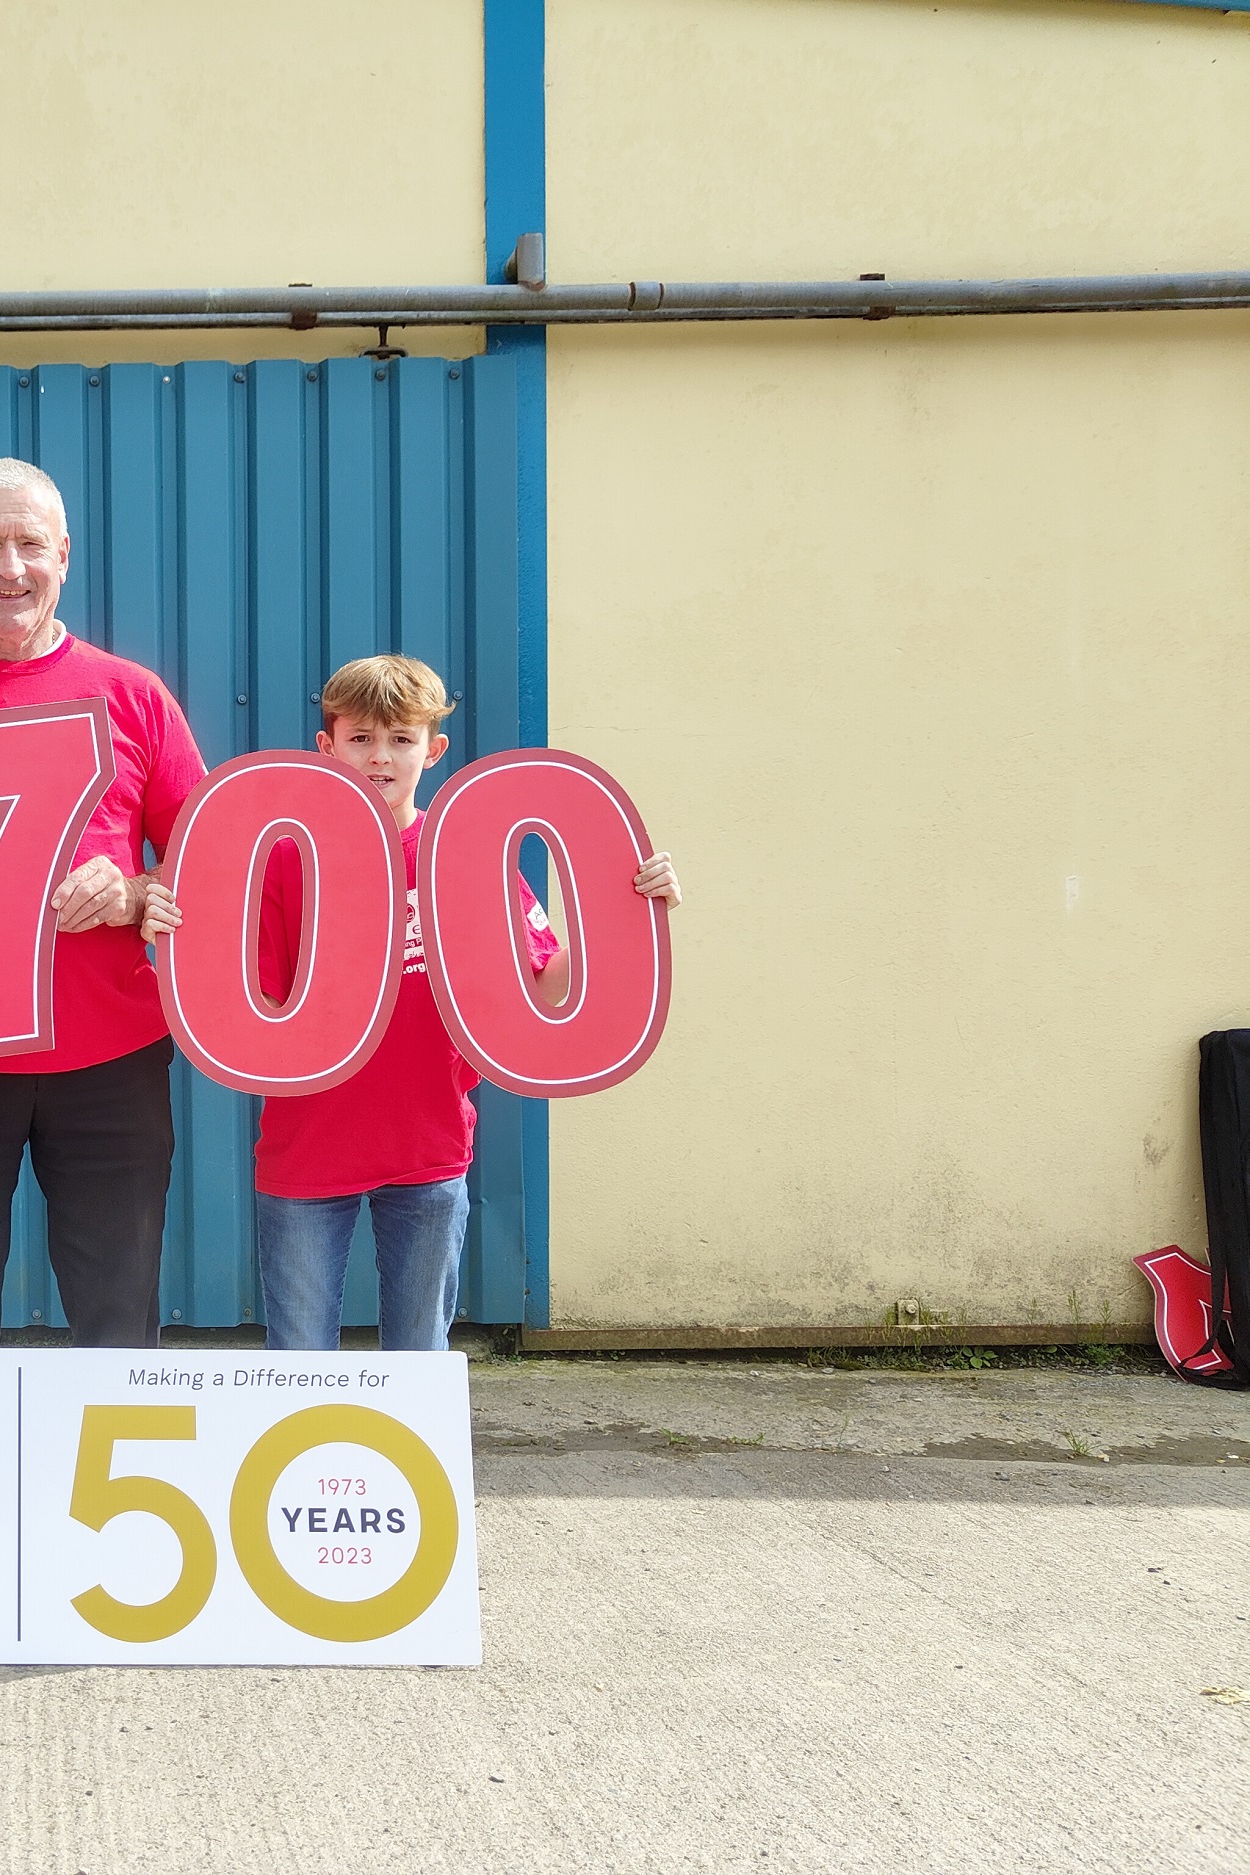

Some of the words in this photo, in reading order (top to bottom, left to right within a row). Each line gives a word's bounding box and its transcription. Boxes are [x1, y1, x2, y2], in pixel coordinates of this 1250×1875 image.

[128, 1367, 205, 1391] Making
[212, 1373, 224, 1386] a
[233, 1368, 350, 1388] Difference
[358, 1369, 390, 1388] for
[318, 1478, 366, 1496] 1973
[70, 1404, 458, 1643] 50
[280, 1507, 406, 1534] YEARS
[317, 1546, 372, 1565] 2023
